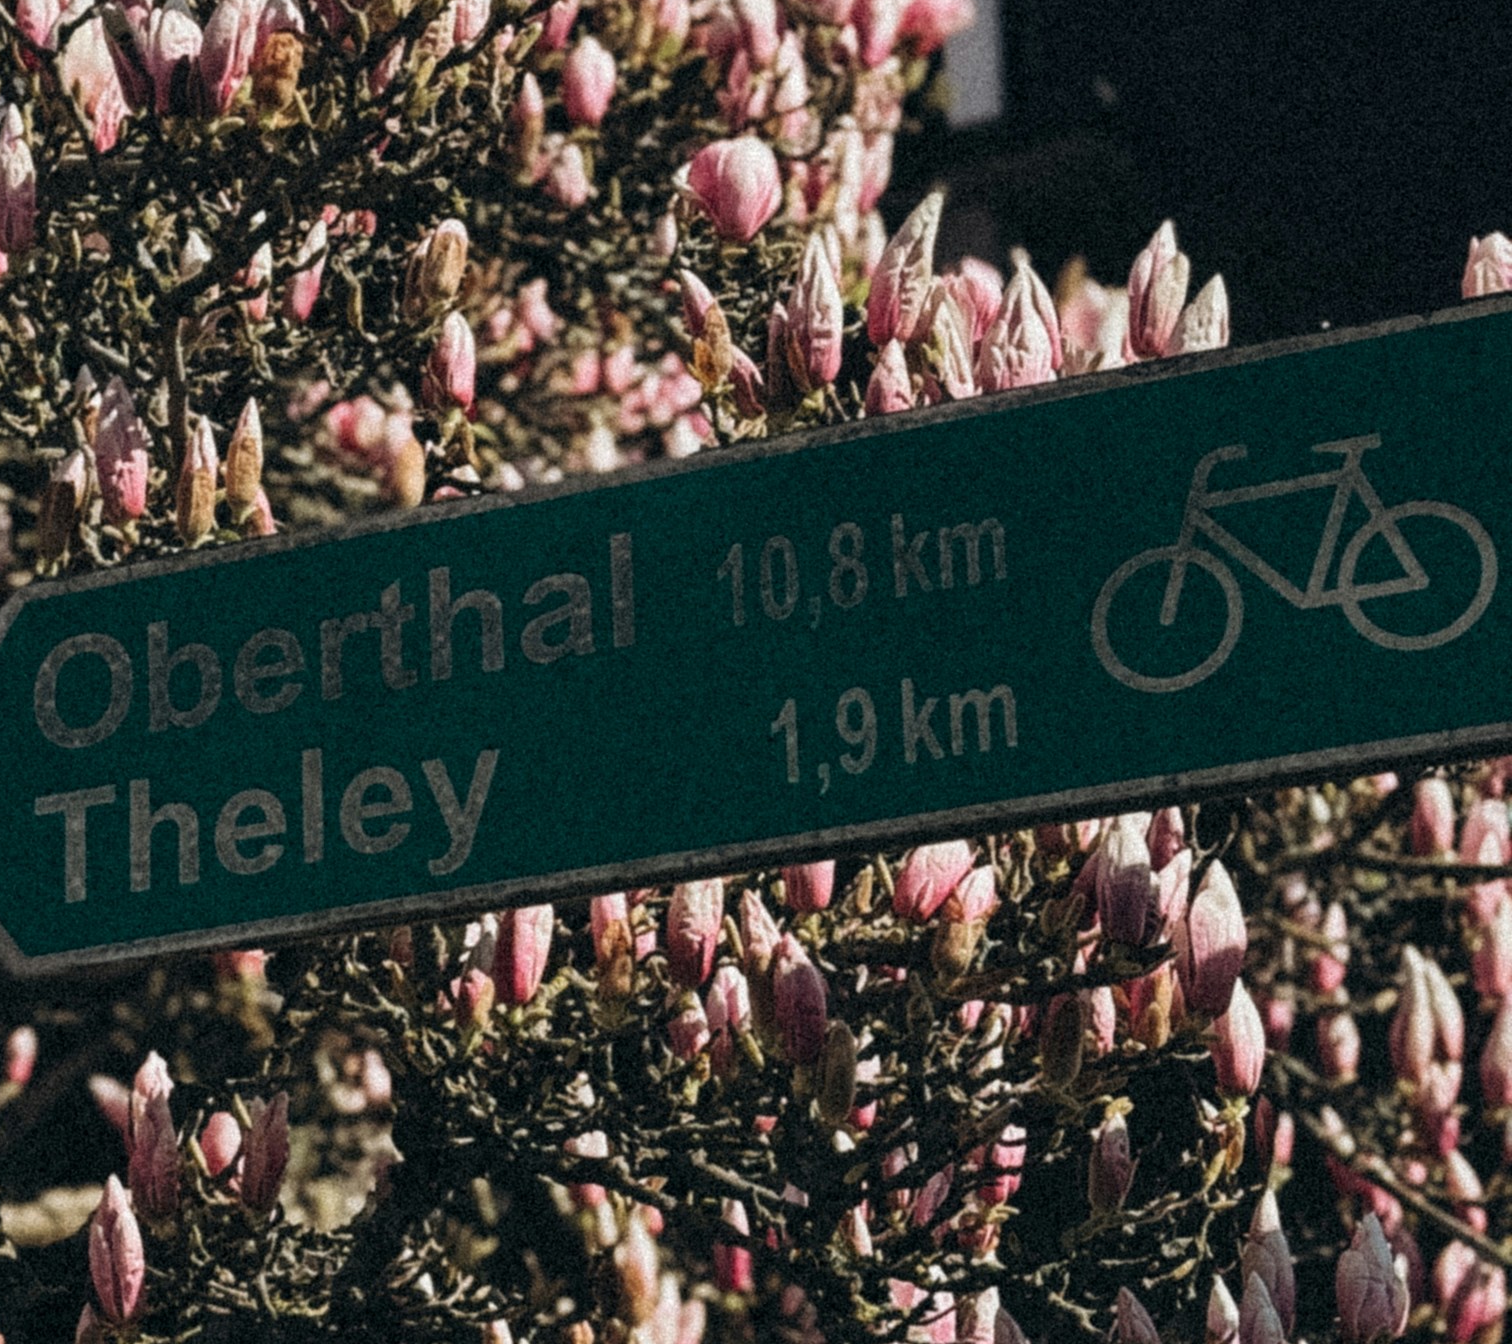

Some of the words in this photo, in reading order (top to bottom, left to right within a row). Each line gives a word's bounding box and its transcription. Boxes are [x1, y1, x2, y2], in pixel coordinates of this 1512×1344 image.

[33, 533, 635, 749] Oberthal
[715, 520, 867, 631] 10,8
[890, 511, 1009, 598] km
[35, 748, 500, 906] Theley
[770, 686, 879, 795] 1,9
[902, 678, 1020, 764] km
